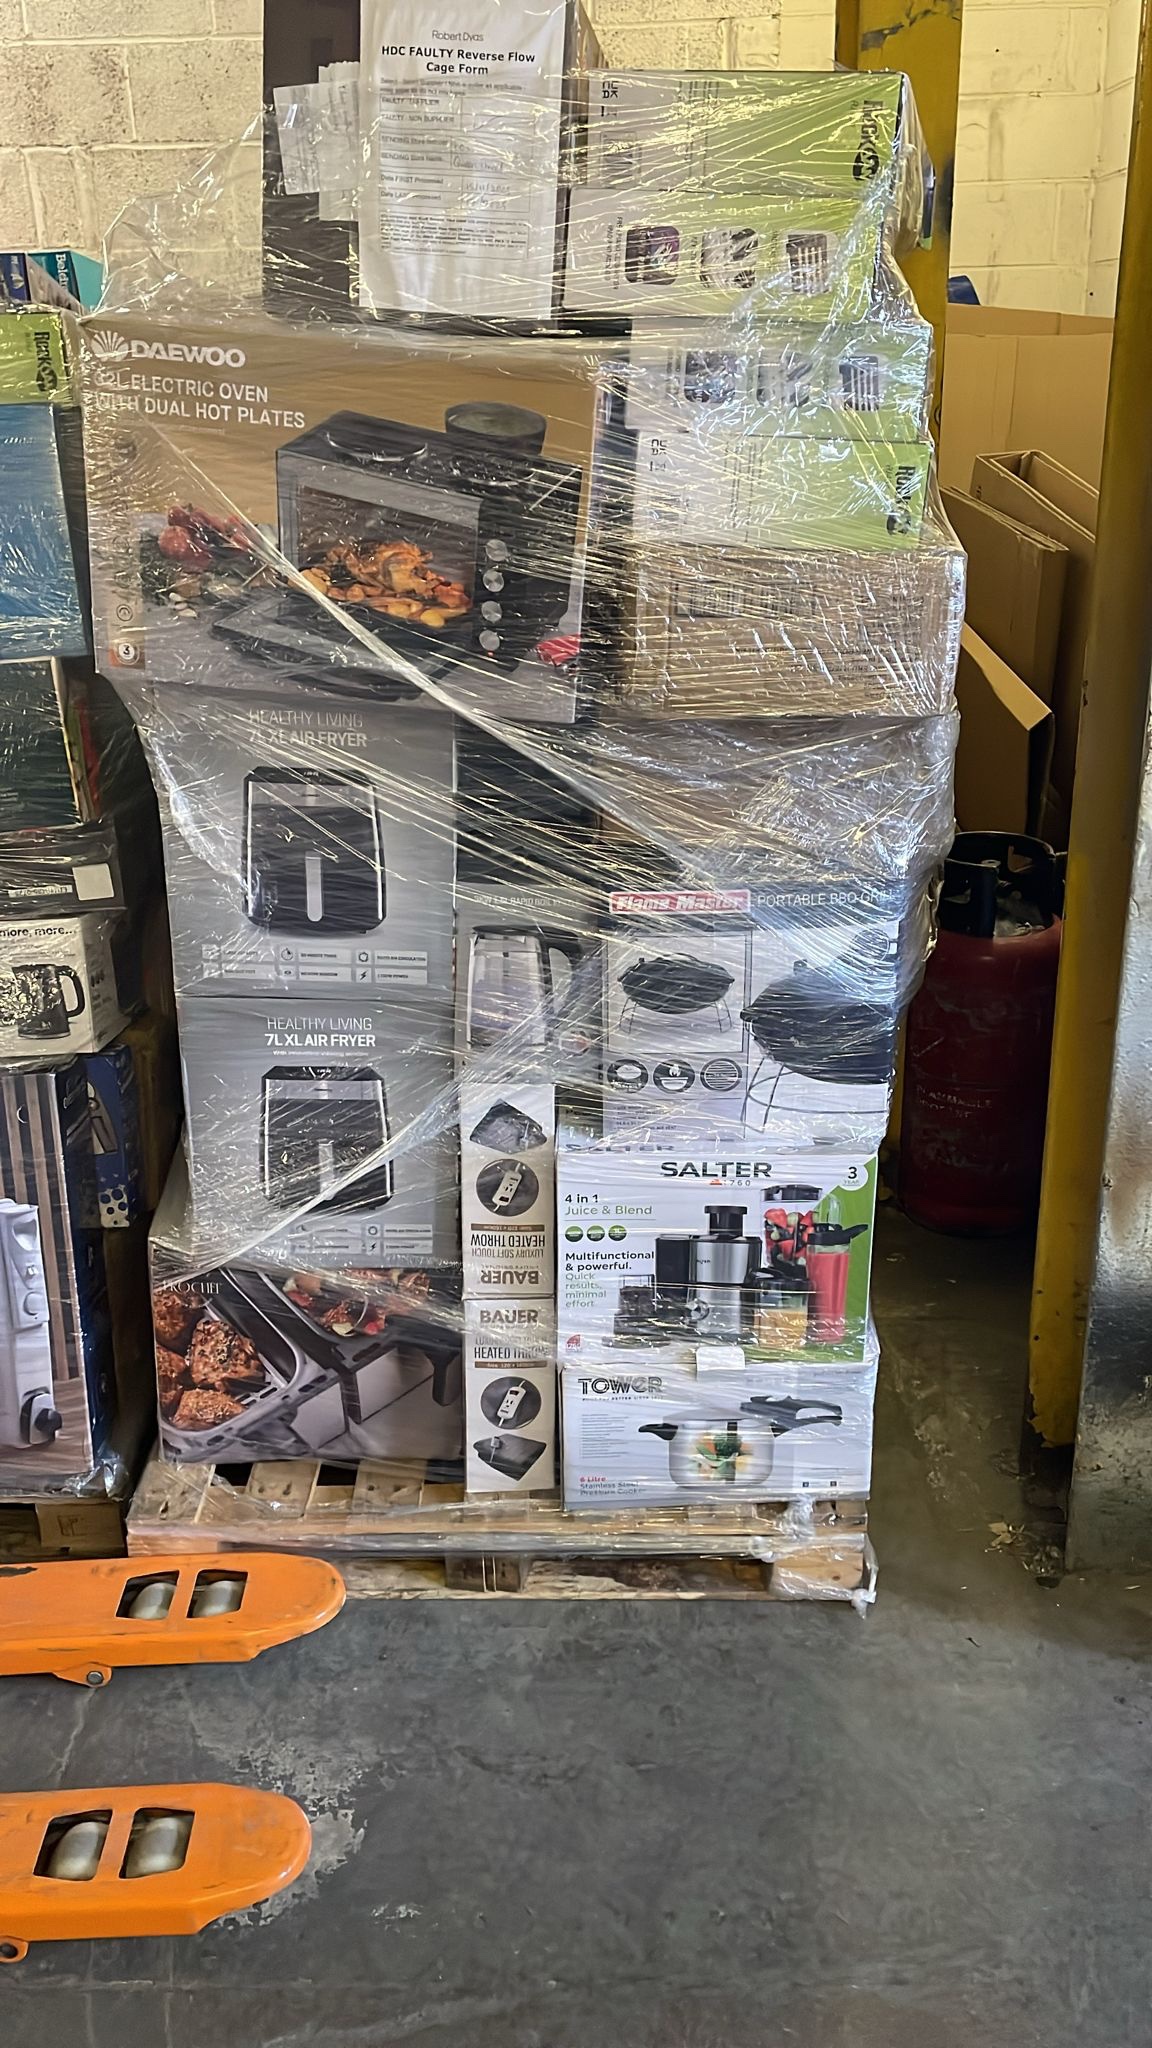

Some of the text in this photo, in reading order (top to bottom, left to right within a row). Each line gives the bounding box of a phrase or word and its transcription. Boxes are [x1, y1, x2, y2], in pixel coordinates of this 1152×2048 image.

[432, 30, 484, 42] Robert Dyas
[381, 46, 536, 62] HDC FAULTY Reverse Flow
[426, 62, 489, 75] Cage Form
[130, 339, 246, 367] DAEWOO
[131, 373, 214, 398] ELECTRIC
[219, 382, 268, 403] OVEN
[145, 397, 190, 418] DUAL
[195, 403, 232, 421] HOT
[238, 407, 305, 428] PLATES
[249, 708, 363, 728] HEALTHY LIVING
[318, 731, 368, 747] FRYER
[757, 893, 826, 907] PORTABLE
[830, 892, 857, 905] BBQ
[267, 1016, 373, 1031] HEALTHY LIVING
[264, 1033, 376, 1047] 7L XL AIR FRYER
[660, 1162, 858, 1179] SALTER 3
[564, 1194, 599, 1204] 4 in 1
[564, 1205, 653, 1216] Juice & Blend
[470, 1233, 545, 1247] HEATED THROW
[471, 1247, 544, 1258] LUXURY SOFT TOUCH
[565, 1251, 655, 1261] Multifunctional
[565, 1262, 632, 1272] & powerful.
[481, 1270, 539, 1284] BAUER
[565, 1272, 595, 1281] Quick
[565, 1290, 607, 1298] minimal
[480, 1309, 539, 1324] BAUER
[474, 1346, 511, 1359] HEATED
[578, 1375, 663, 1395] TOWER
